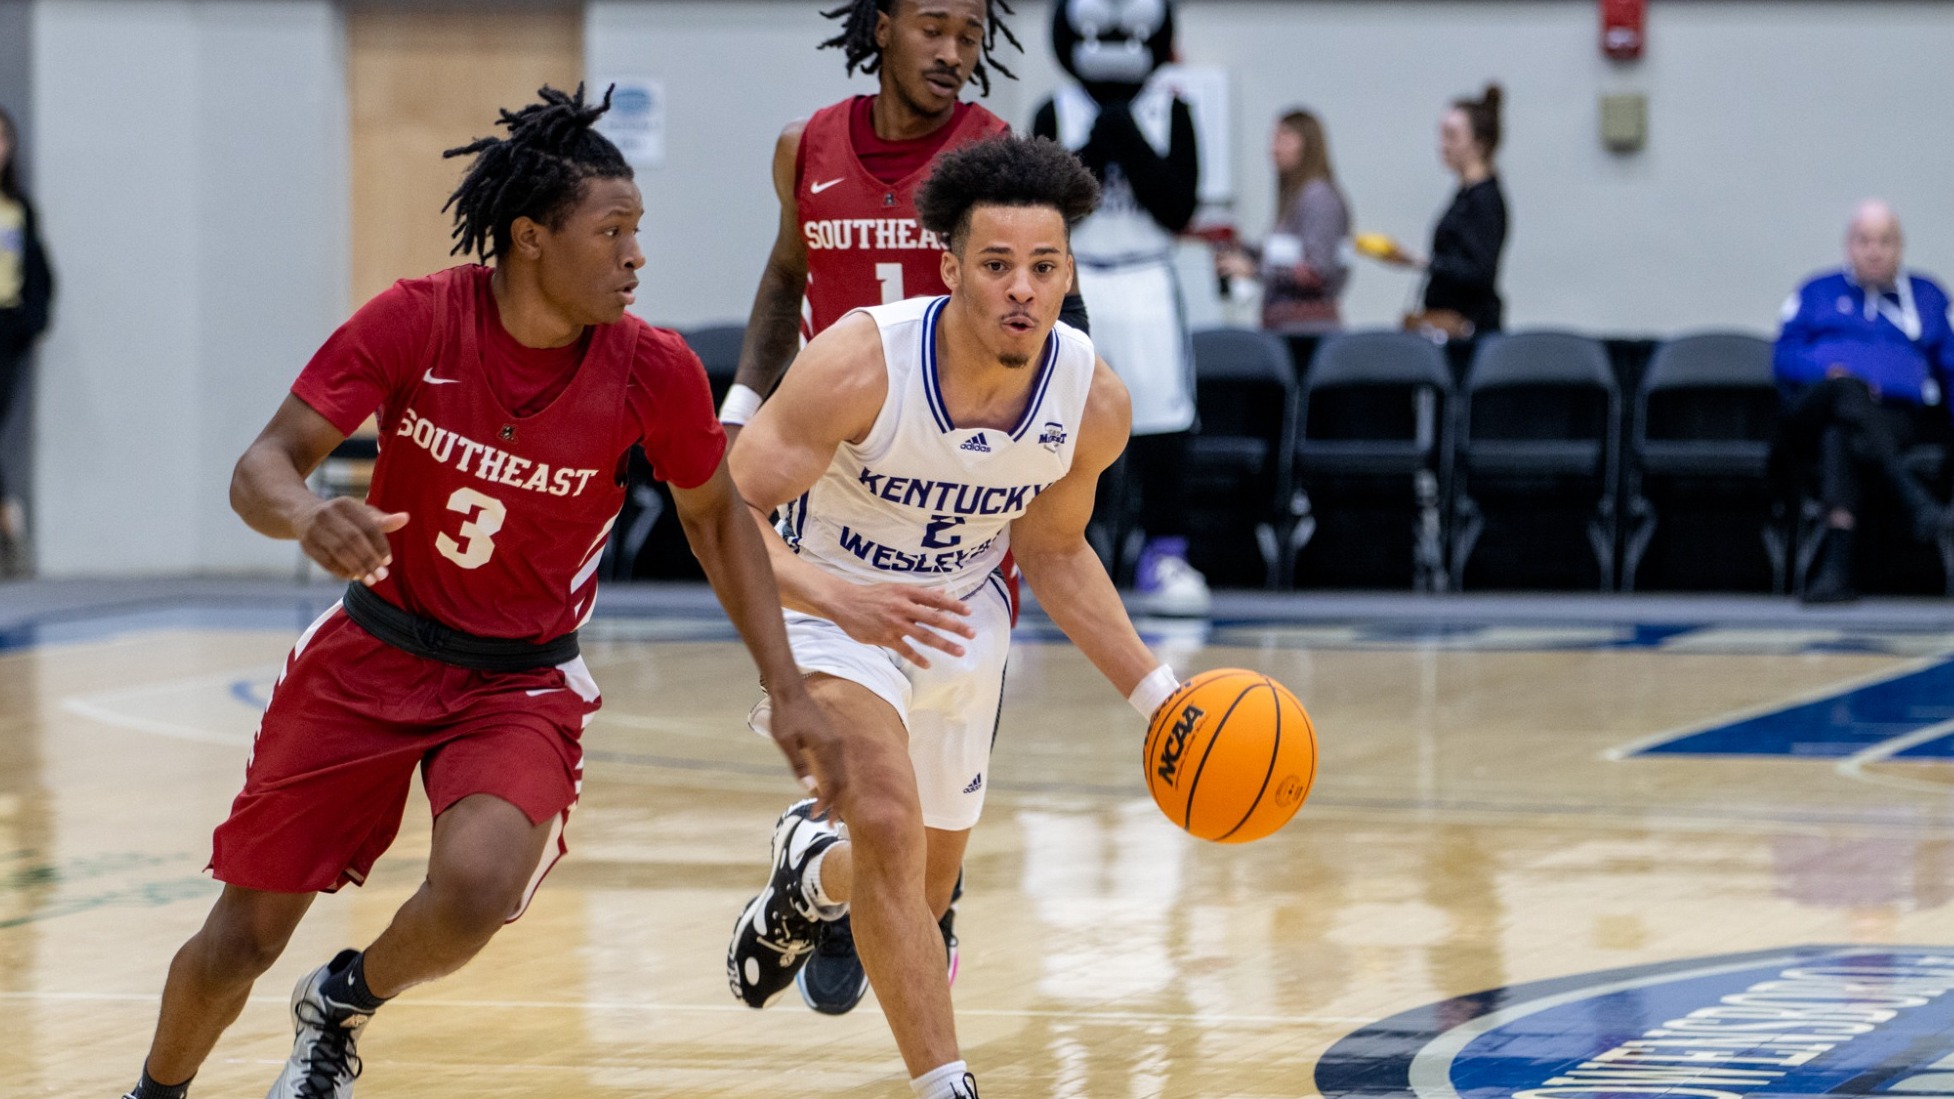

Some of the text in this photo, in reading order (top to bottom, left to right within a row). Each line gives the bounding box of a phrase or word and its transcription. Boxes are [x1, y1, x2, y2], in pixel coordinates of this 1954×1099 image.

[804, 218, 950, 250] SOUTHEA
[875, 262, 904, 305] 1
[397, 407, 599, 497] SOUTHEAST
[960, 443, 991, 453] adidas
[435, 486, 507, 570] 3
[839, 526, 1002, 573] WESLEY
[920, 514, 966, 549] 2
[1158, 704, 1204, 787] NCAA
